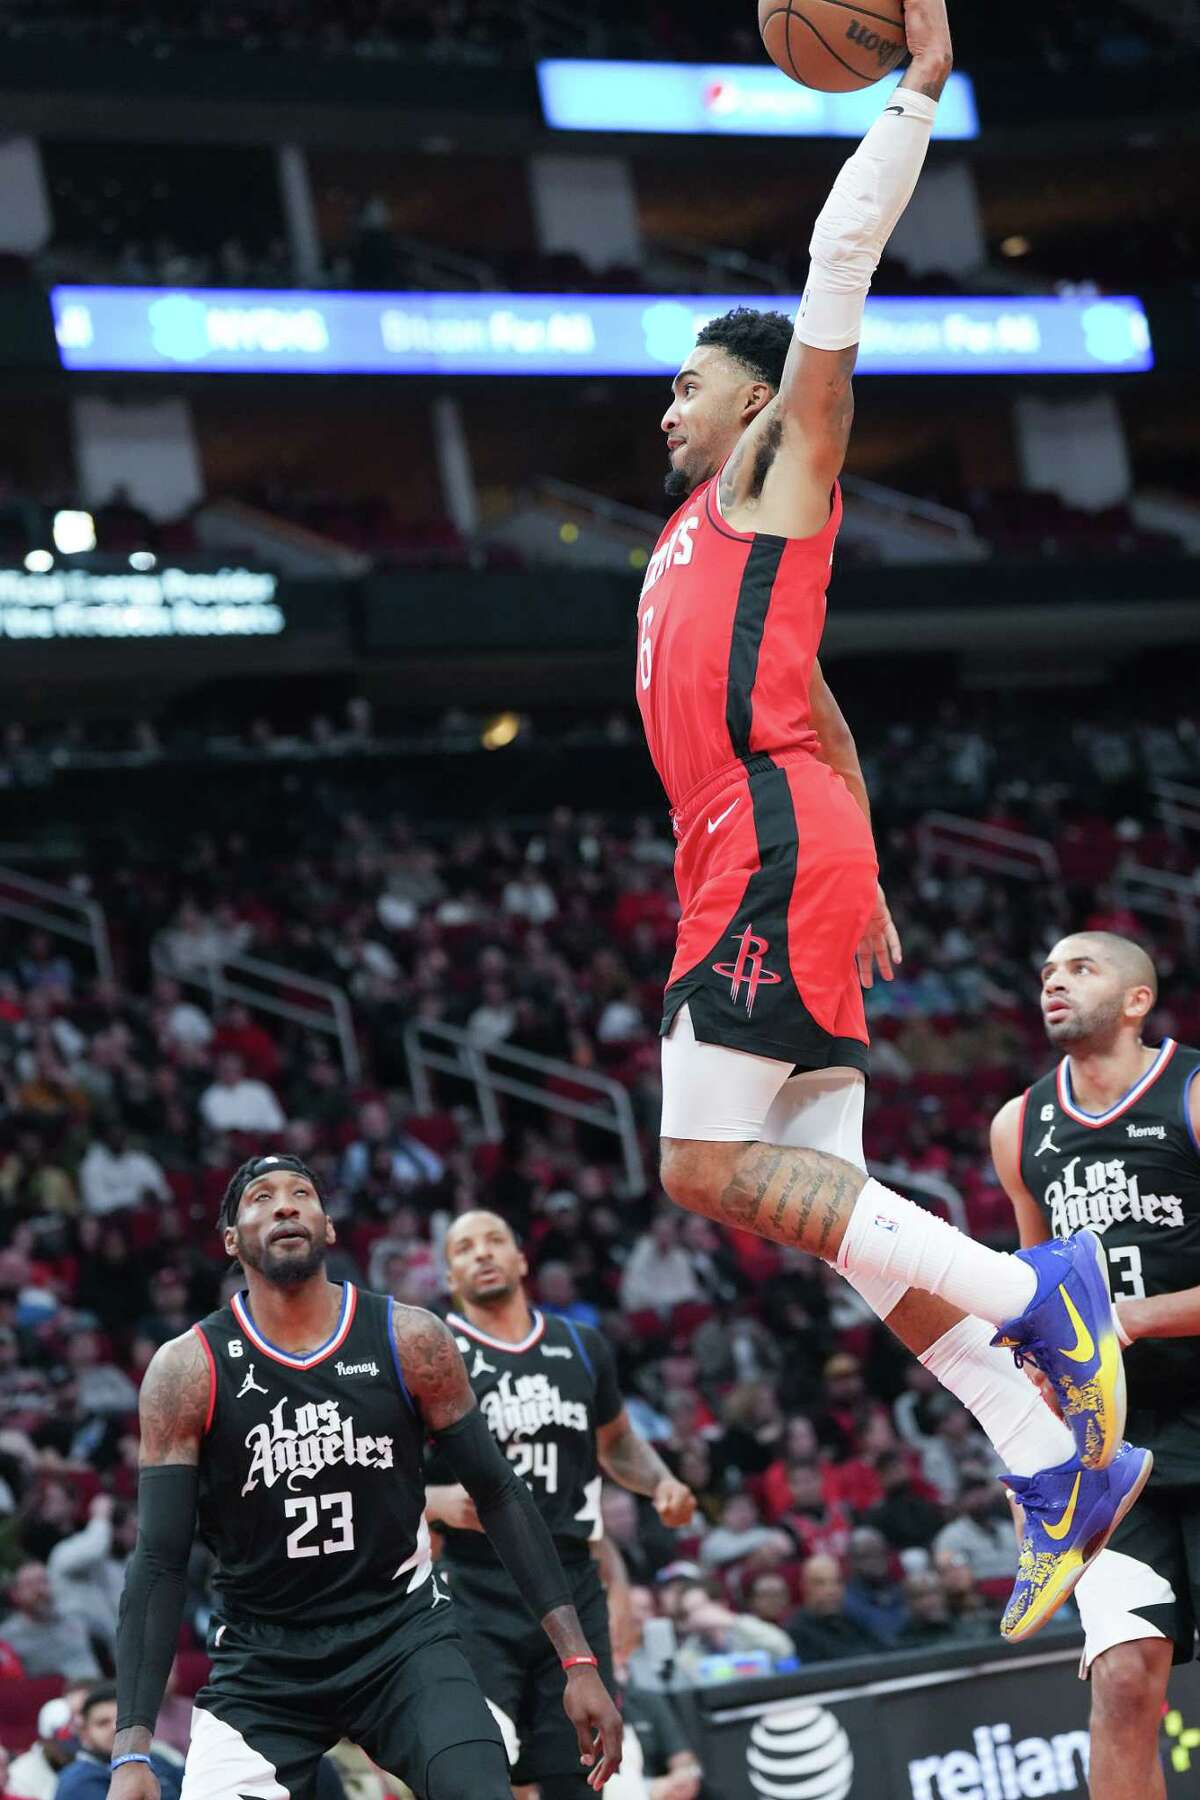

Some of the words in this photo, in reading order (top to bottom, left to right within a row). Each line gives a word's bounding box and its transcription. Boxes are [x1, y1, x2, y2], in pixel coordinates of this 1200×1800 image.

[640, 606, 654, 691] 6
[1040, 1104, 1056, 1121] 6
[1126, 1124, 1167, 1140] honey
[1062, 1156, 1127, 1197] Los
[1045, 1175, 1185, 1245] Angeles
[1109, 1245, 1146, 1304] 3
[227, 1339, 244, 1358] 6
[334, 1361, 380, 1377] honey
[497, 1370, 551, 1402] Los
[270, 1396, 341, 1442] Los
[241, 1416, 394, 1497] Angeles
[284, 1491, 355, 1559] 23
[908, 1722, 1092, 1800] relian
